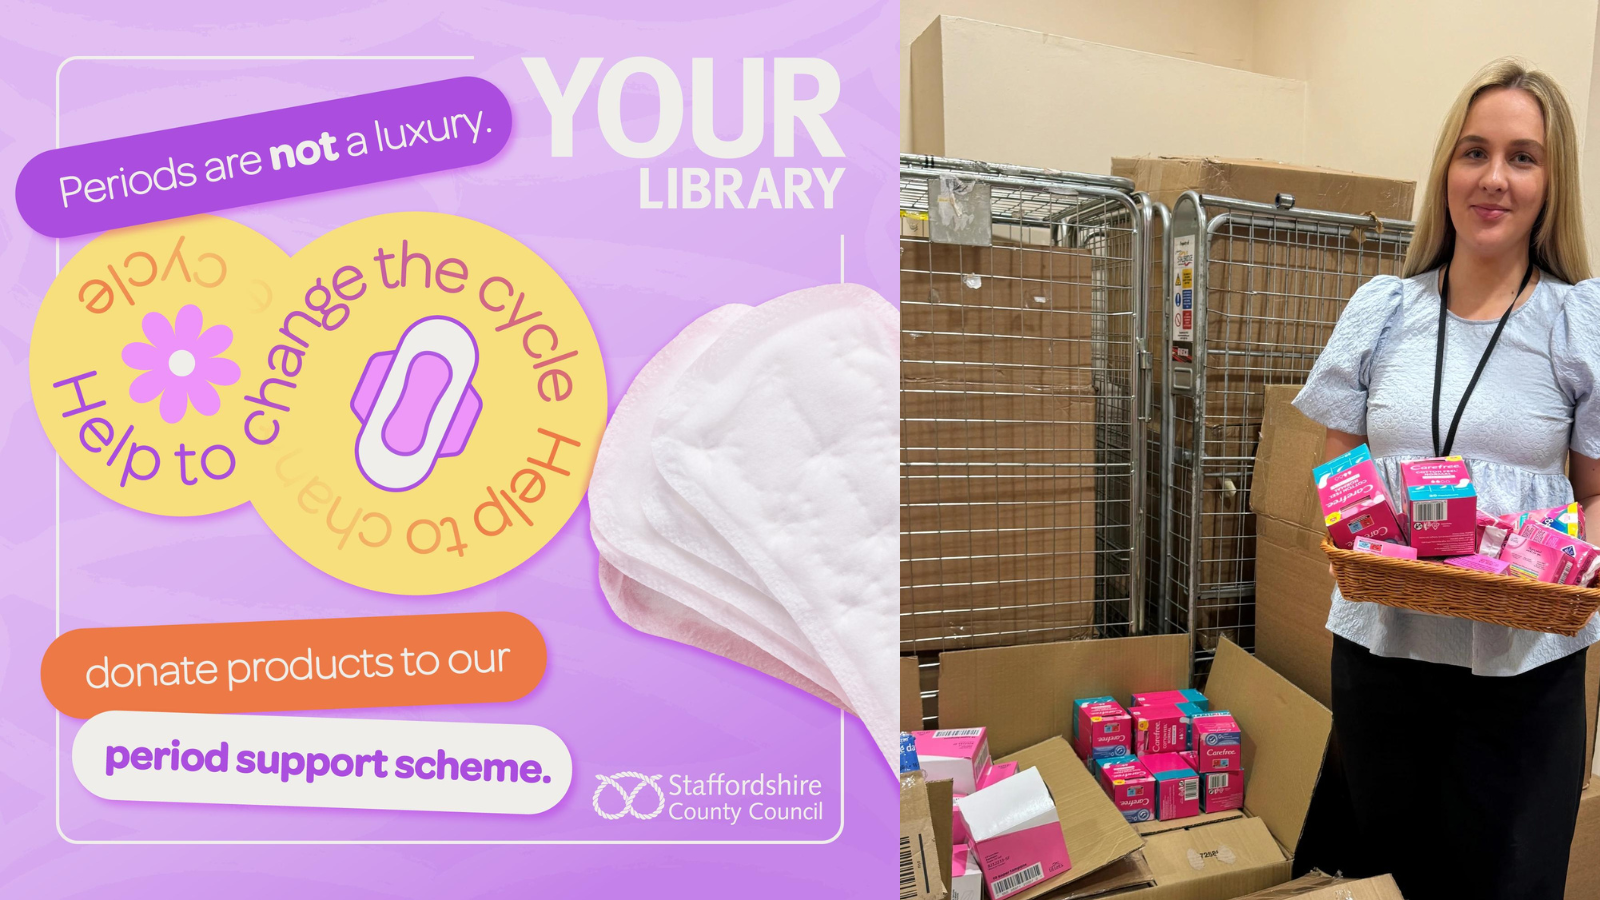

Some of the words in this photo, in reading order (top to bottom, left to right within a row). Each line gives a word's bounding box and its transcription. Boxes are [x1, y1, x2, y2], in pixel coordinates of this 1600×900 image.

[521, 57, 846, 159] YOUR
[60, 156, 198, 208] Periods
[204, 150, 262, 183] are
[269, 131, 340, 171] not
[347, 132, 368, 156] a
[374, 111, 492, 152] luxury.
[640, 168, 846, 209] LIBRARY
[79, 236, 227, 315] cycle
[53, 371, 161, 487] Help
[174, 443, 236, 486] to
[243, 265, 367, 446] change
[373, 239, 468, 294] the
[479, 276, 578, 402] cycle
[474, 427, 581, 537] Help
[1326, 484, 1374, 508] Carefree
[406, 516, 468, 557] to
[85, 655, 218, 689] donate
[228, 647, 394, 692] products
[400, 647, 440, 677] to
[448, 648, 511, 674] our
[1098, 735, 1127, 743] Carefree
[1152, 721, 1161, 753] Carefree
[105, 739, 229, 776] period
[235, 749, 389, 784] support
[394, 748, 552, 784] scheme.
[668, 773, 822, 796] Staffordshire
[1120, 798, 1150, 806] Carefree
[668, 802, 742, 826] County
[749, 801, 823, 820] Council
